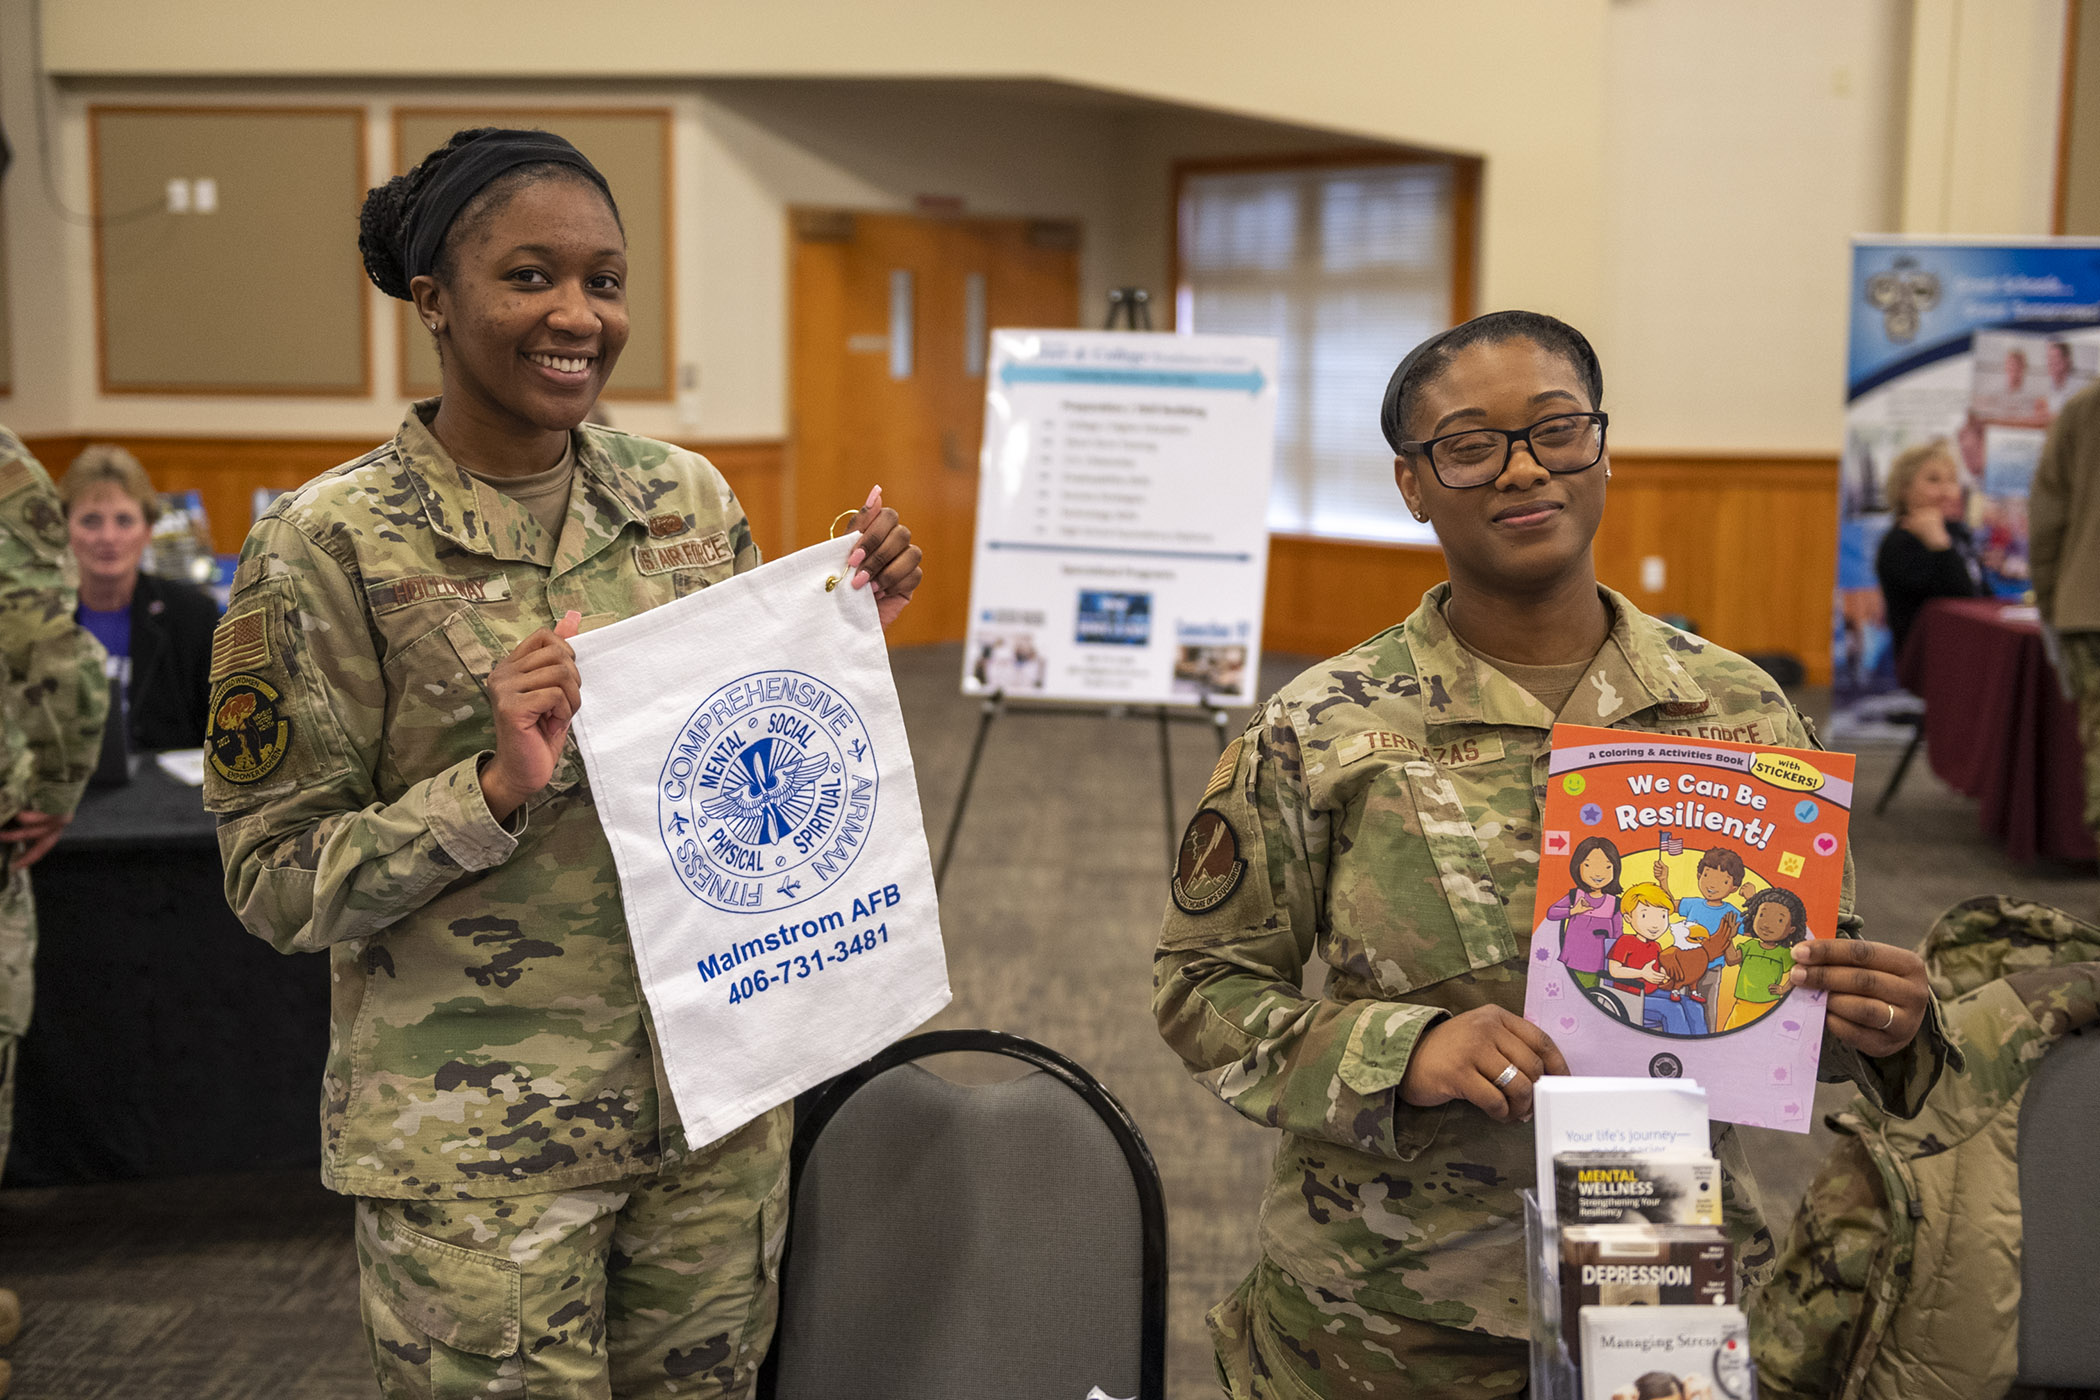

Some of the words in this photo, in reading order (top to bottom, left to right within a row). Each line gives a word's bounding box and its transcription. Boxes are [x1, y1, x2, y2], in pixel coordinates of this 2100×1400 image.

[657, 546, 685, 568] AIR
[680, 537, 728, 565] FORCE
[392, 577, 488, 606] HOLLOWAY
[235, 676, 260, 688] WOMEN
[664, 677, 854, 802] COMPREHENSIVE
[767, 712, 817, 749] SOCIAL
[227, 769, 260, 780] EMPOWER
[259, 747, 282, 773] WOMEN
[699, 729, 746, 789] MENTAL
[1364, 731, 1480, 766] TERRAZAS
[1588, 751, 1596, 760] A
[1599, 748, 1645, 759] Coloring
[1647, 748, 1656, 757] &
[1658, 748, 1713, 761] Activities
[1716, 753, 1744, 766] Book
[1778, 758, 1801, 771] with
[1627, 773, 1671, 796] We
[1677, 773, 1730, 800] Can
[1734, 783, 1768, 811] Be
[1755, 762, 1818, 789] STICKERS!
[793, 778, 842, 854] SPIRITUAL
[811, 774, 873, 882] AIRMAN
[1615, 800, 1777, 851] Resilient!
[707, 827, 764, 872] PHYSICAL
[677, 838, 763, 907] FITNESS
[1217, 862, 1241, 897] SQUADRON
[696, 911, 845, 983] Malmstrom
[851, 883, 901, 923] AFB
[728, 922, 889, 1006] 406-731-3481
[1565, 1130, 1593, 1143] Your
[1595, 1129, 1626, 1143] life's
[1578, 1169, 1638, 1183] MENTAL
[1578, 1182, 1654, 1196] WELLNESS
[1578, 1198, 1640, 1209] Strengthening
[1641, 1198, 1661, 1207] Your
[1578, 1208, 1623, 1219] Resiliency
[1581, 1264, 1692, 1286] DEPRESSION
[1600, 1335, 1674, 1351] Managing
[1677, 1333, 1719, 1347] Stress
